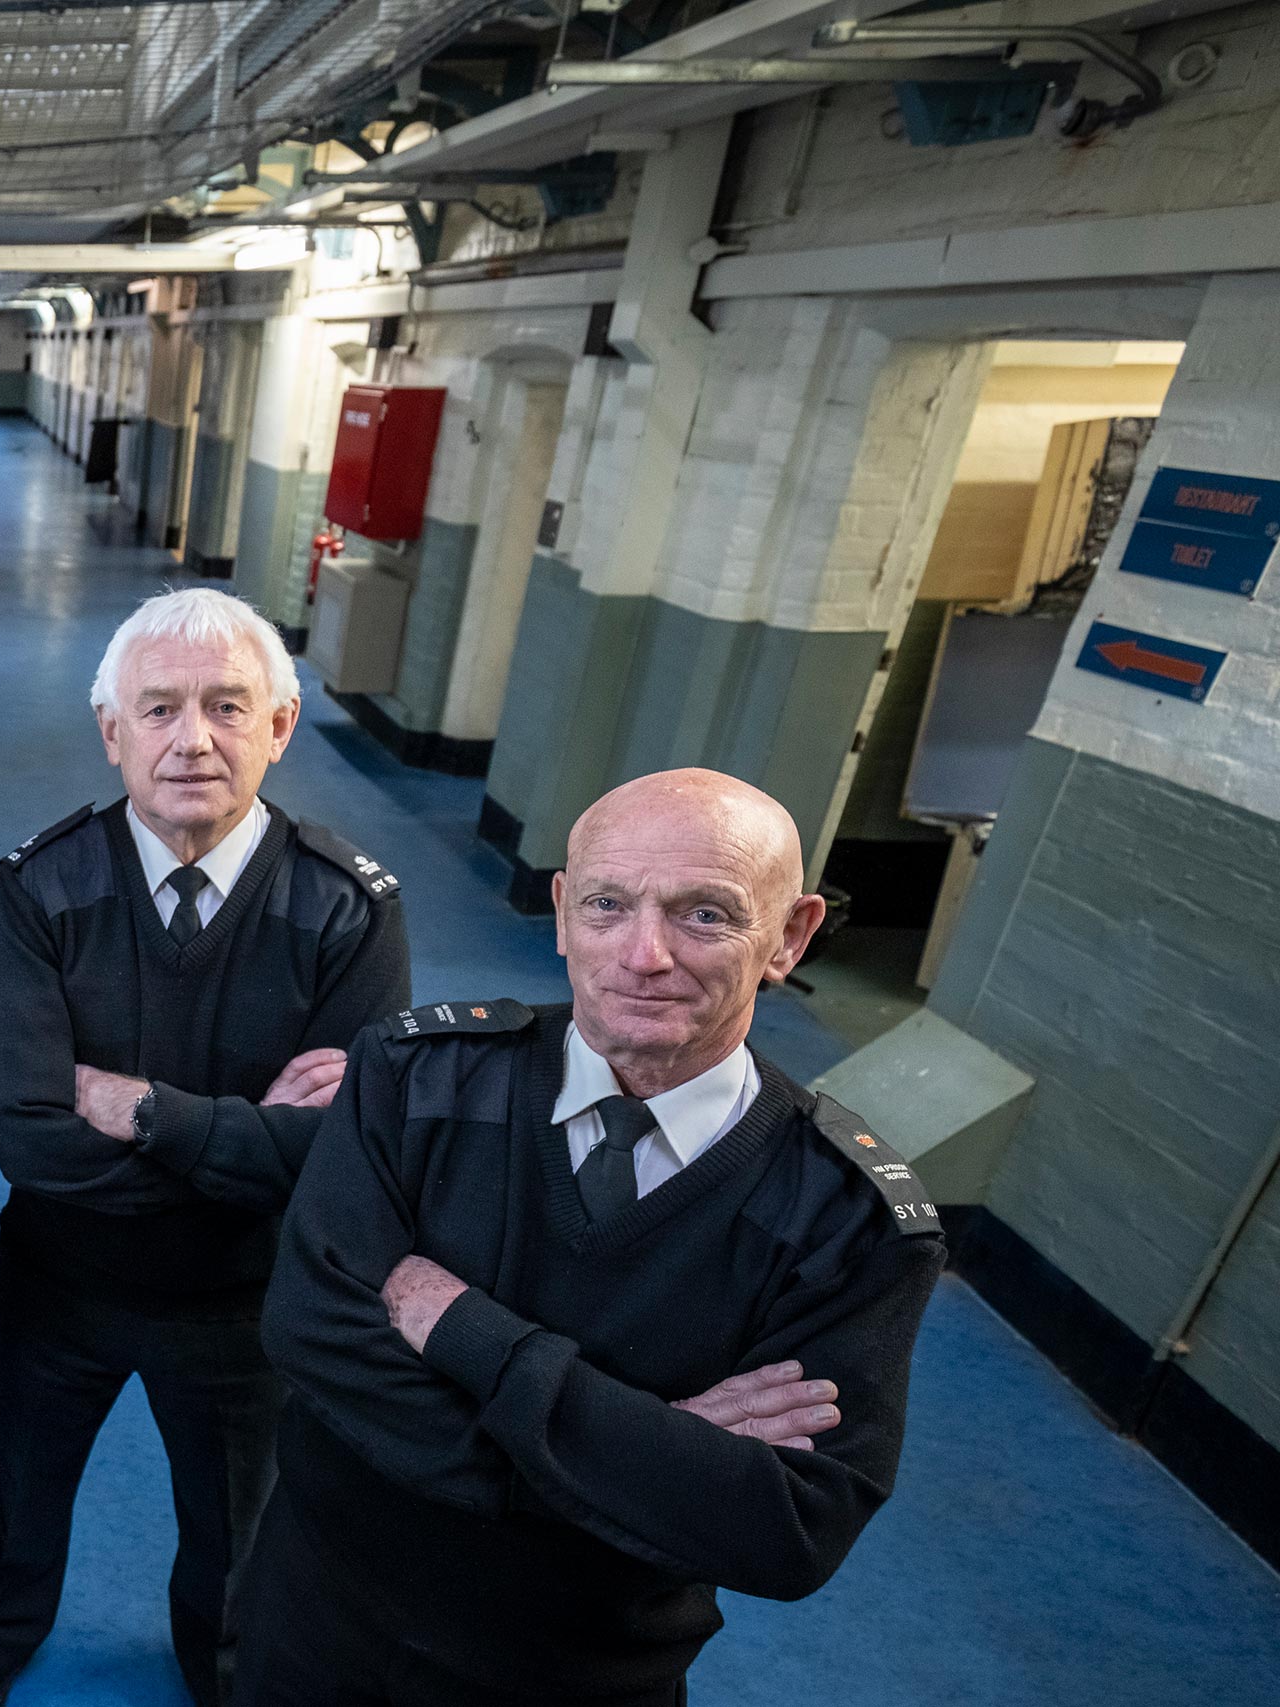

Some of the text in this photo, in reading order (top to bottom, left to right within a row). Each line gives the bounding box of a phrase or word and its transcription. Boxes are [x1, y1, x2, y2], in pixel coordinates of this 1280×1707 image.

[371, 879, 387, 892] SY
[403, 1018, 420, 1034] 104
[884, 1171, 911, 1180] SERVICE
[894, 1203, 917, 1219] SY
